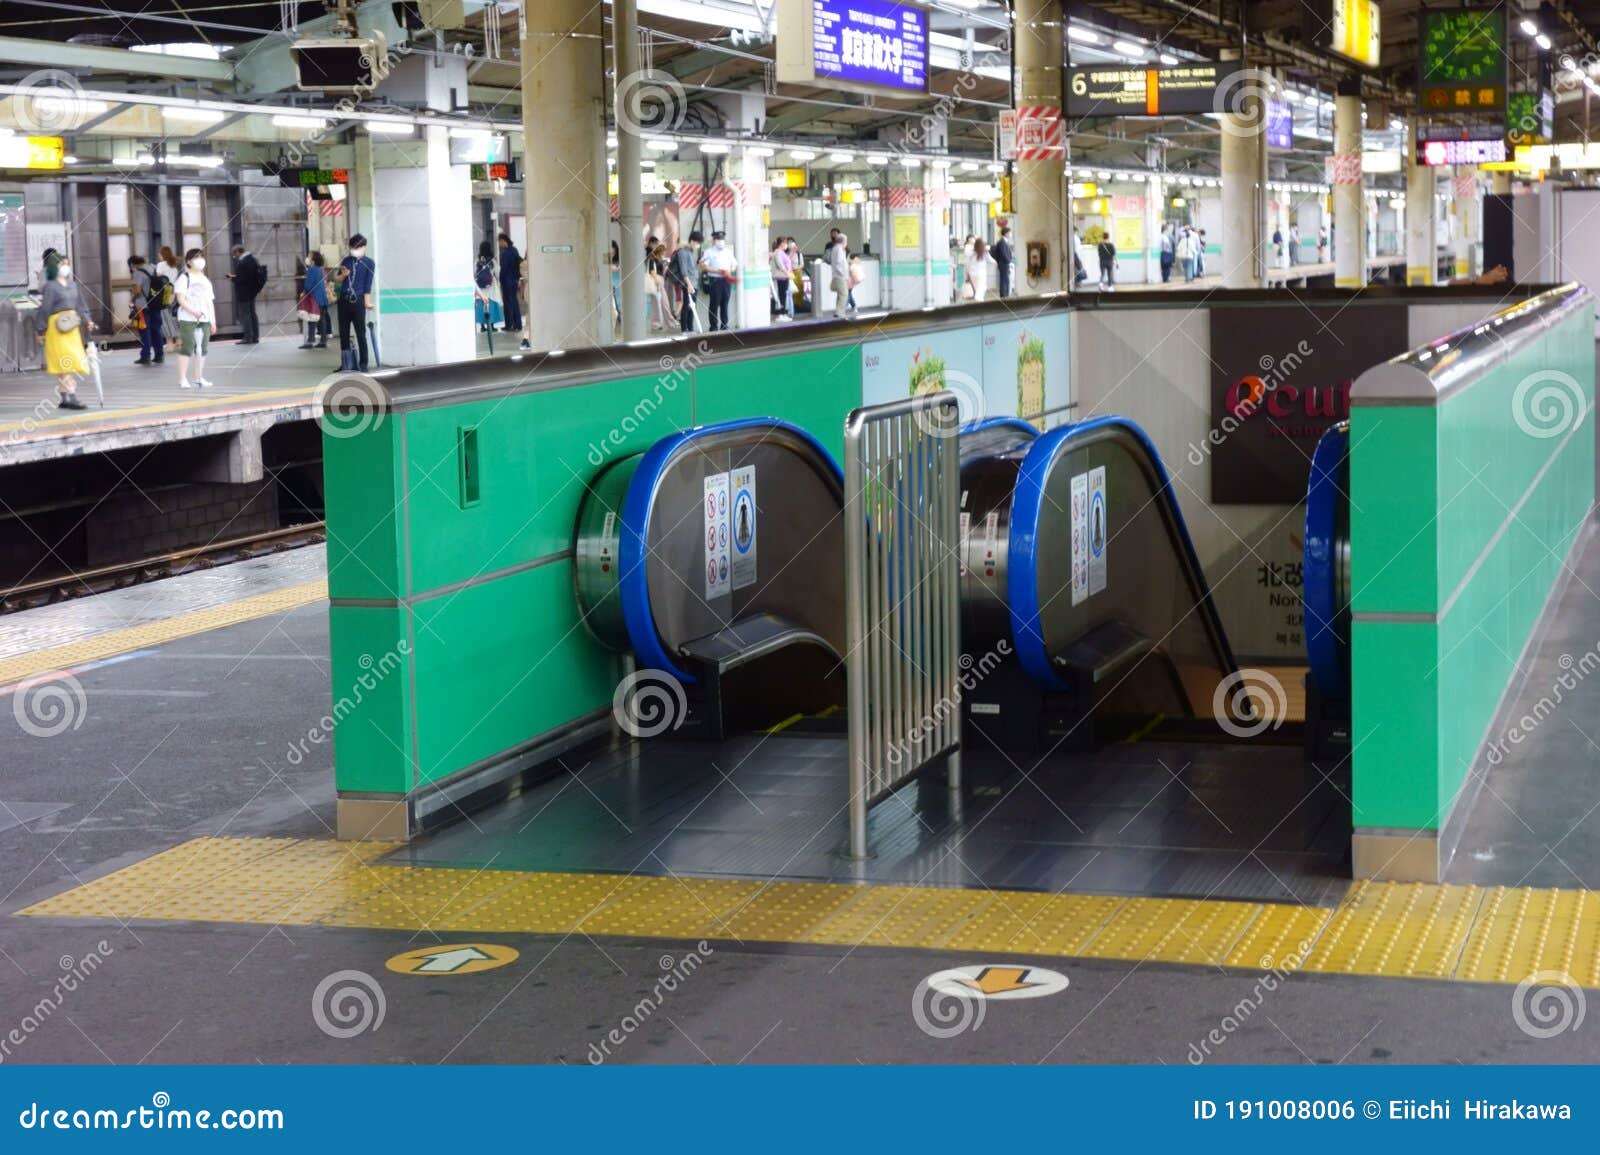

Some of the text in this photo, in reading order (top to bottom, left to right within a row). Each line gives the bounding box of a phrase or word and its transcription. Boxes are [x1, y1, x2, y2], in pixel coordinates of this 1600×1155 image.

[841, 27, 902, 74] 東京家政大学
[1072, 73, 1087, 96] 6
